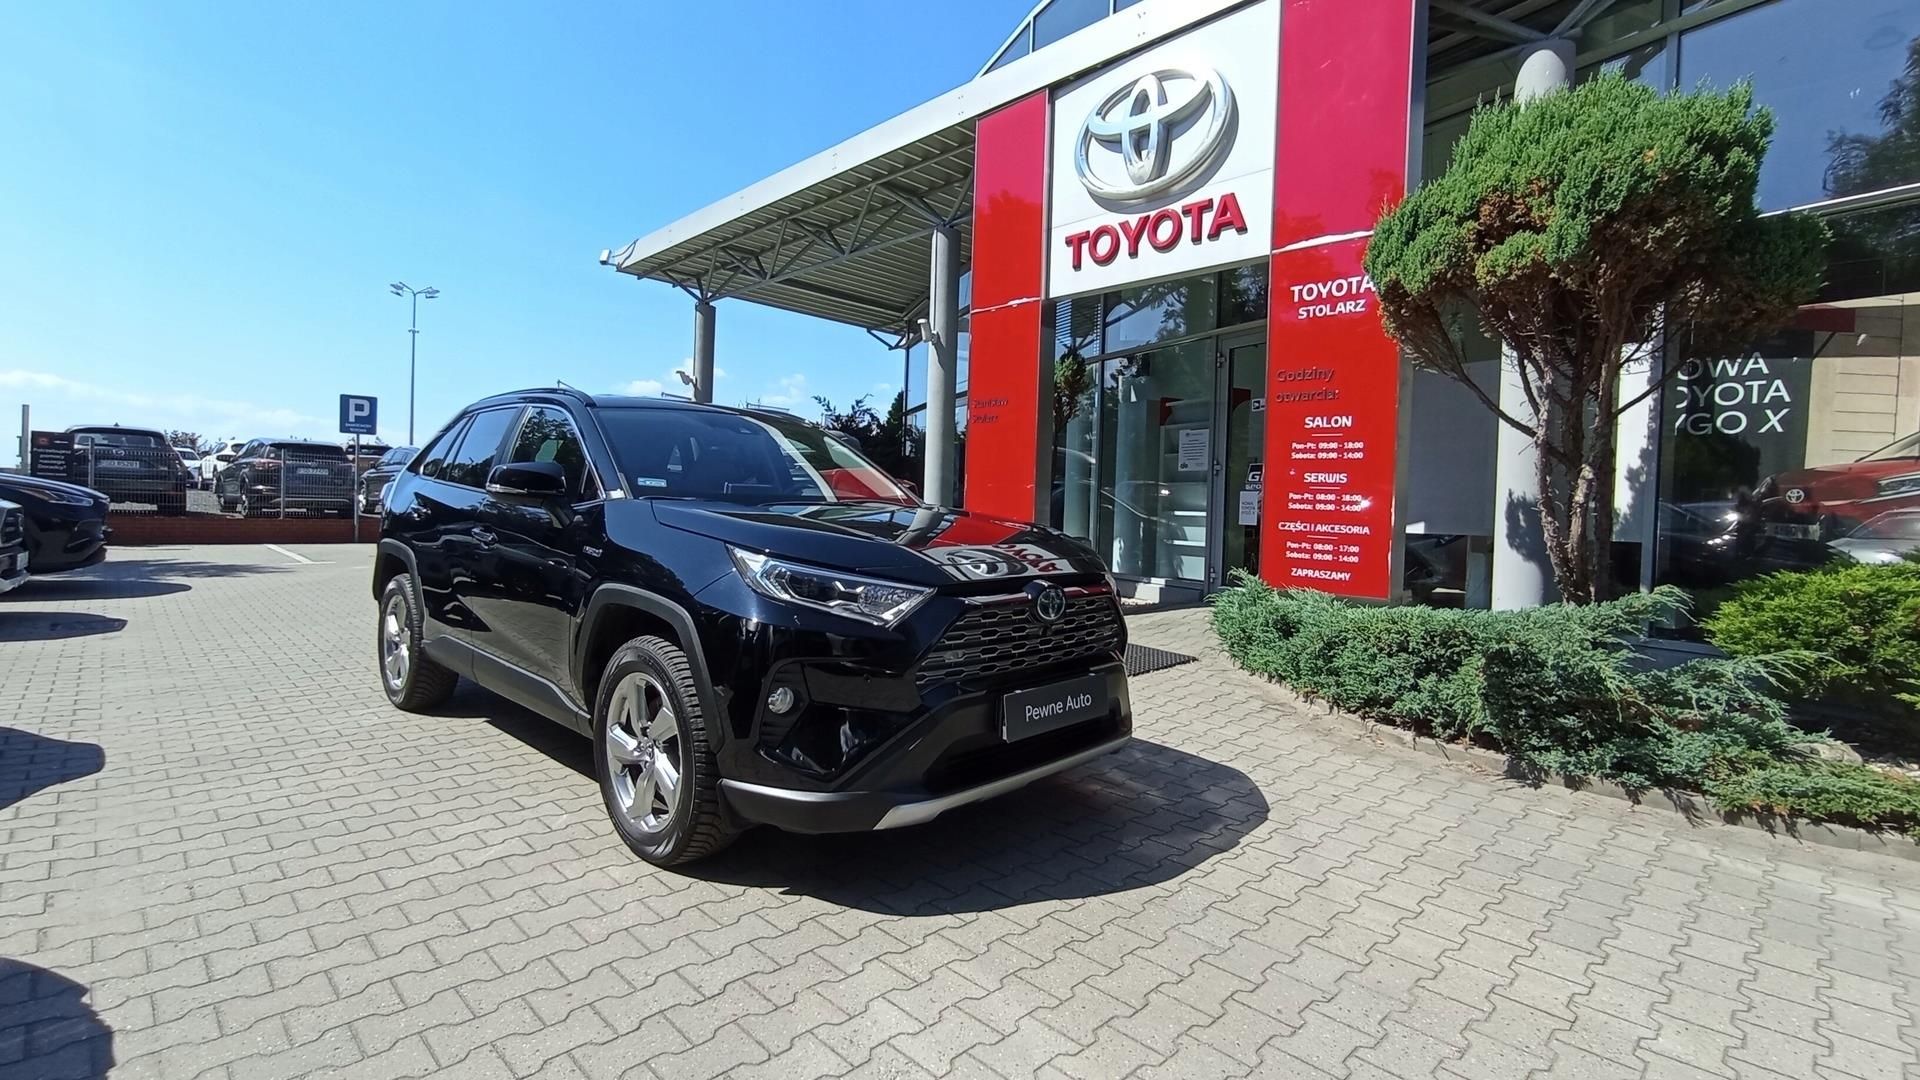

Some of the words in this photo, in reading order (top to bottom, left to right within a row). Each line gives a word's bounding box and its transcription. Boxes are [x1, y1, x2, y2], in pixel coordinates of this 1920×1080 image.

[1065, 193, 1248, 272] TOYOTA
[1290, 275, 1376, 302] TOYOTA
[1298, 299, 1366, 319] STOLARZ
[1276, 366, 1334, 382] Godziny
[1677, 351, 1770, 380] OWA
[348, 398, 370, 422] P
[1757, 408, 1791, 433] X
[1304, 415, 1352, 428] SALON
[1304, 472, 1348, 484] SERWIS
[1278, 520, 1310, 532] CZĘŚCI
[1315, 523, 1371, 535] AKCESORIA
[1291, 567, 1352, 581] ZAPRASZAMY
[1025, 701, 1064, 722] Pewne
[1066, 693, 1092, 712] Auto
